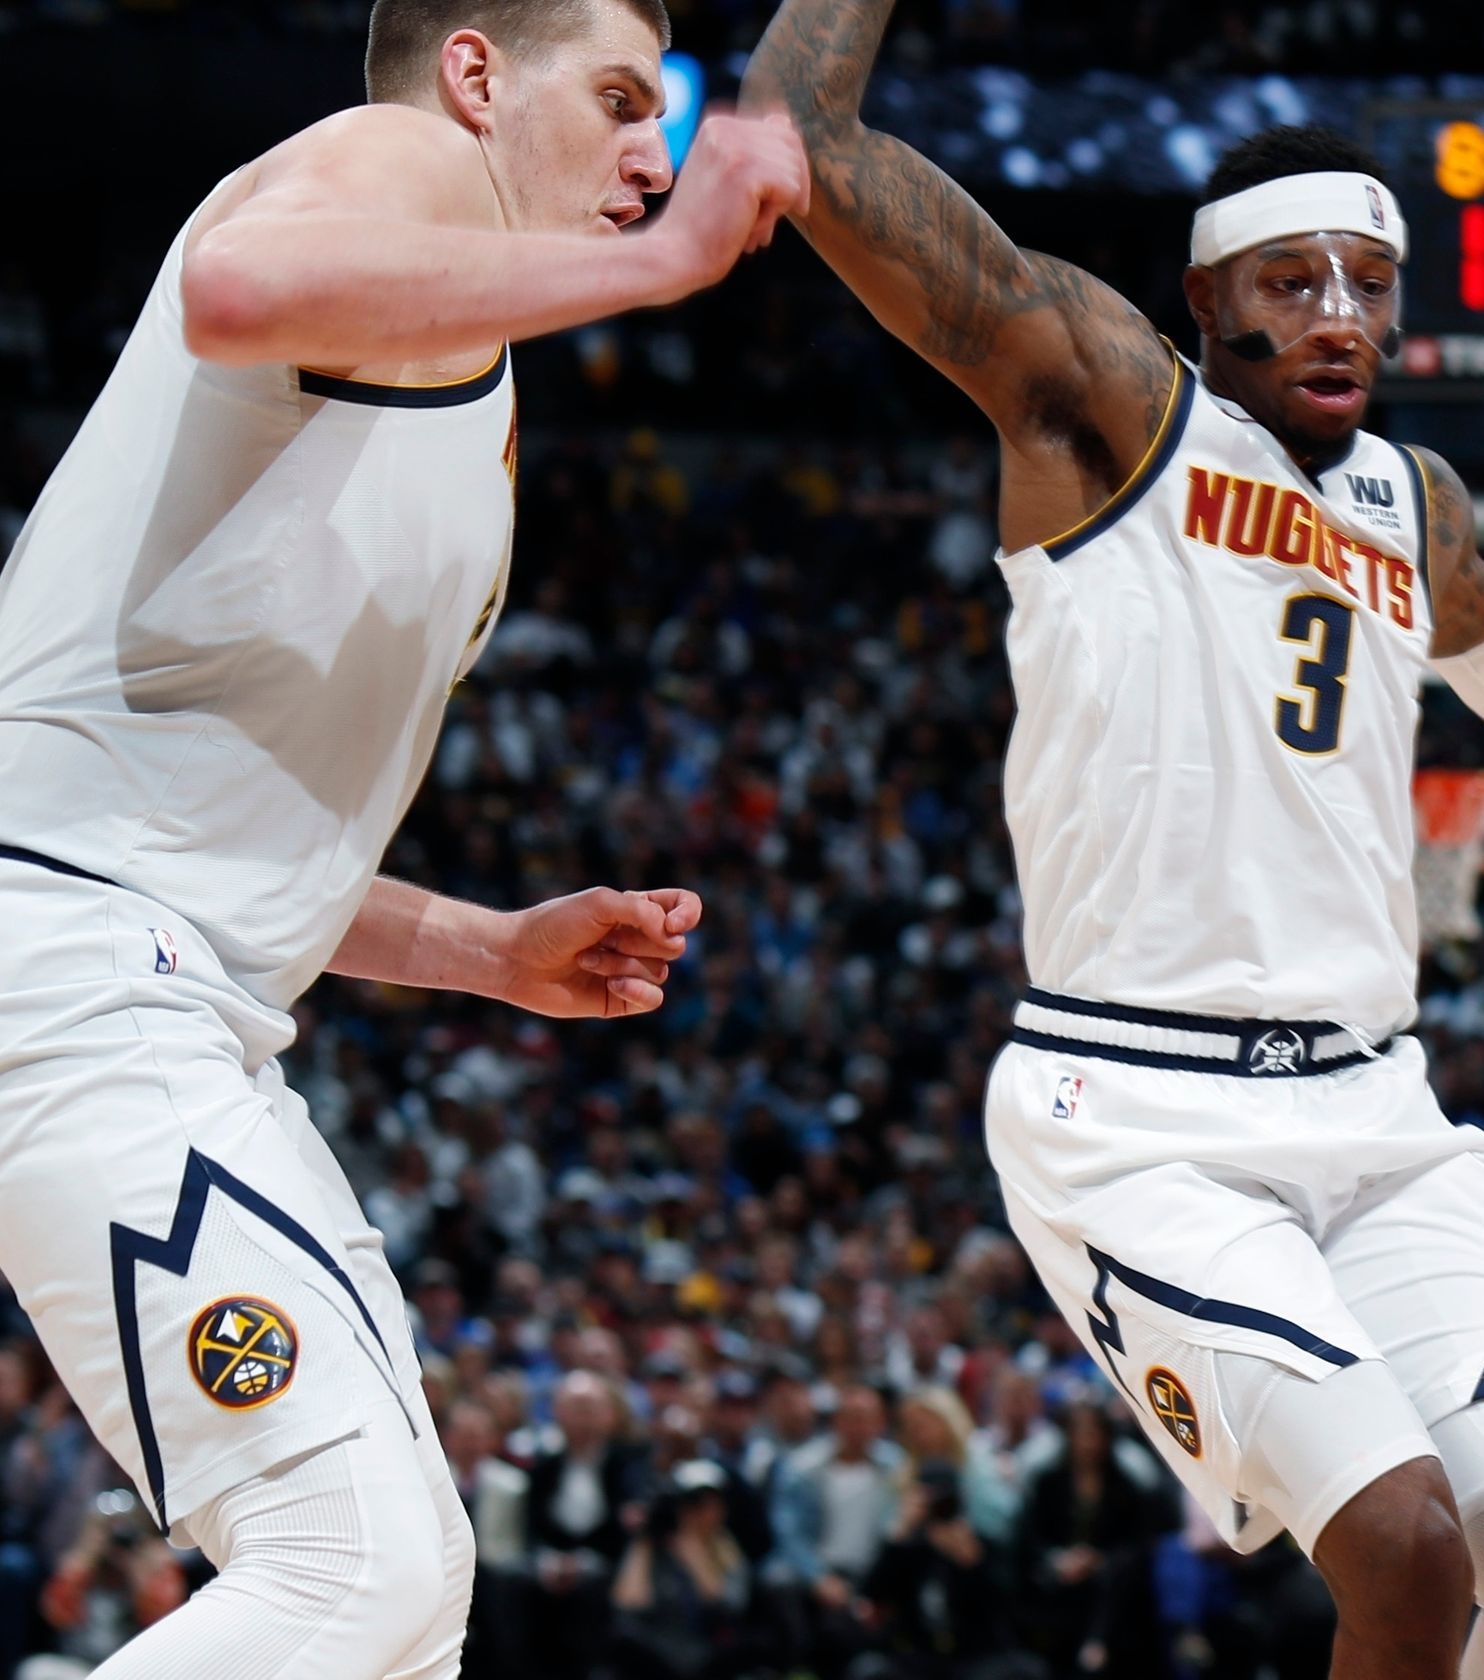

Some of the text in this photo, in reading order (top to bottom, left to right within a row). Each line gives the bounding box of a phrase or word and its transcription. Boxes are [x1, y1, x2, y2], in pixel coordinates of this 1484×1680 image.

[1343, 472, 1394, 508] WU
[1352, 505, 1399, 520] WESTERN
[1368, 517, 1401, 530] UNION
[1273, 591, 1356, 757] 3
